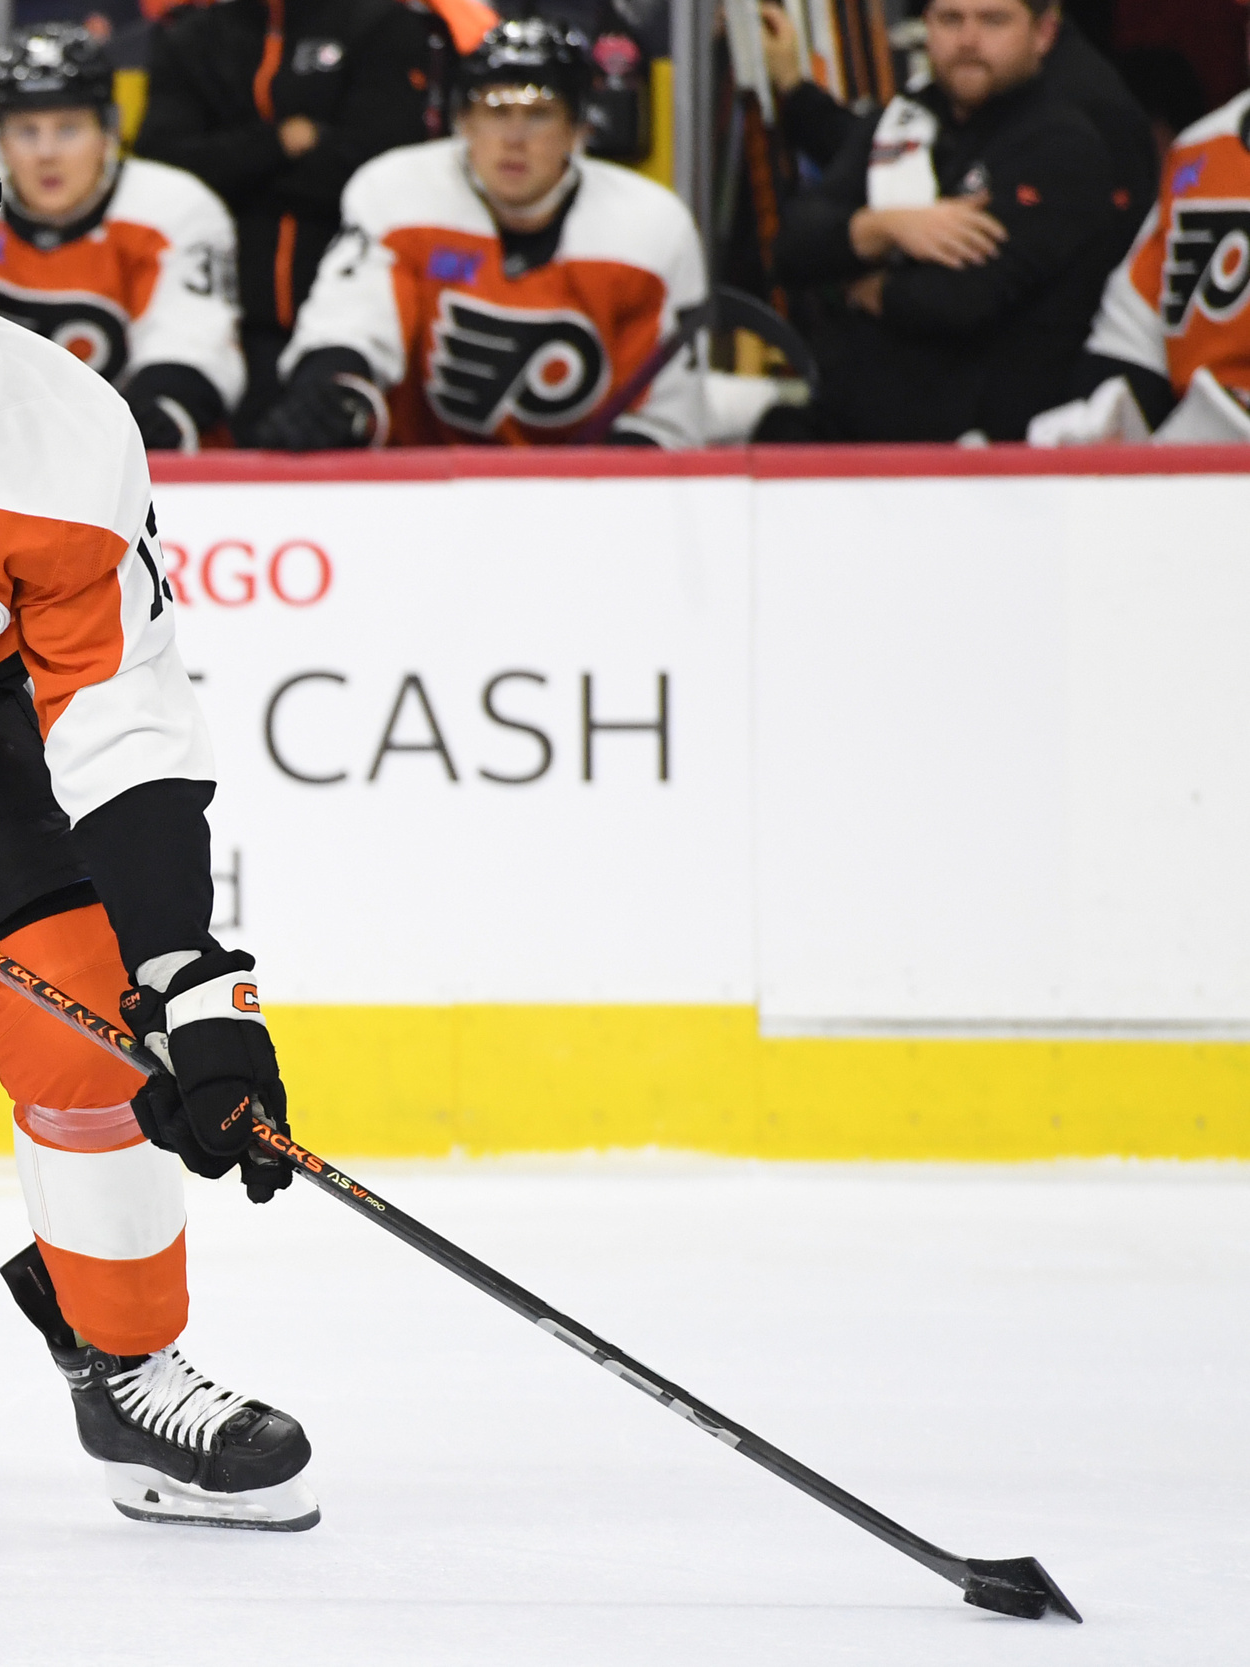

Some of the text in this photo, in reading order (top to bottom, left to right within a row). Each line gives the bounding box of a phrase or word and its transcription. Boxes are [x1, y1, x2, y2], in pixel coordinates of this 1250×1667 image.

[263, 669, 672, 787] CASH
[0, 957, 110, 1032] CCM
[121, 992, 141, 1009] CCM
[220, 1095, 250, 1131] CCM
[252, 1117, 325, 1174] ACKS
[364, 1195, 386, 1212] PRO
